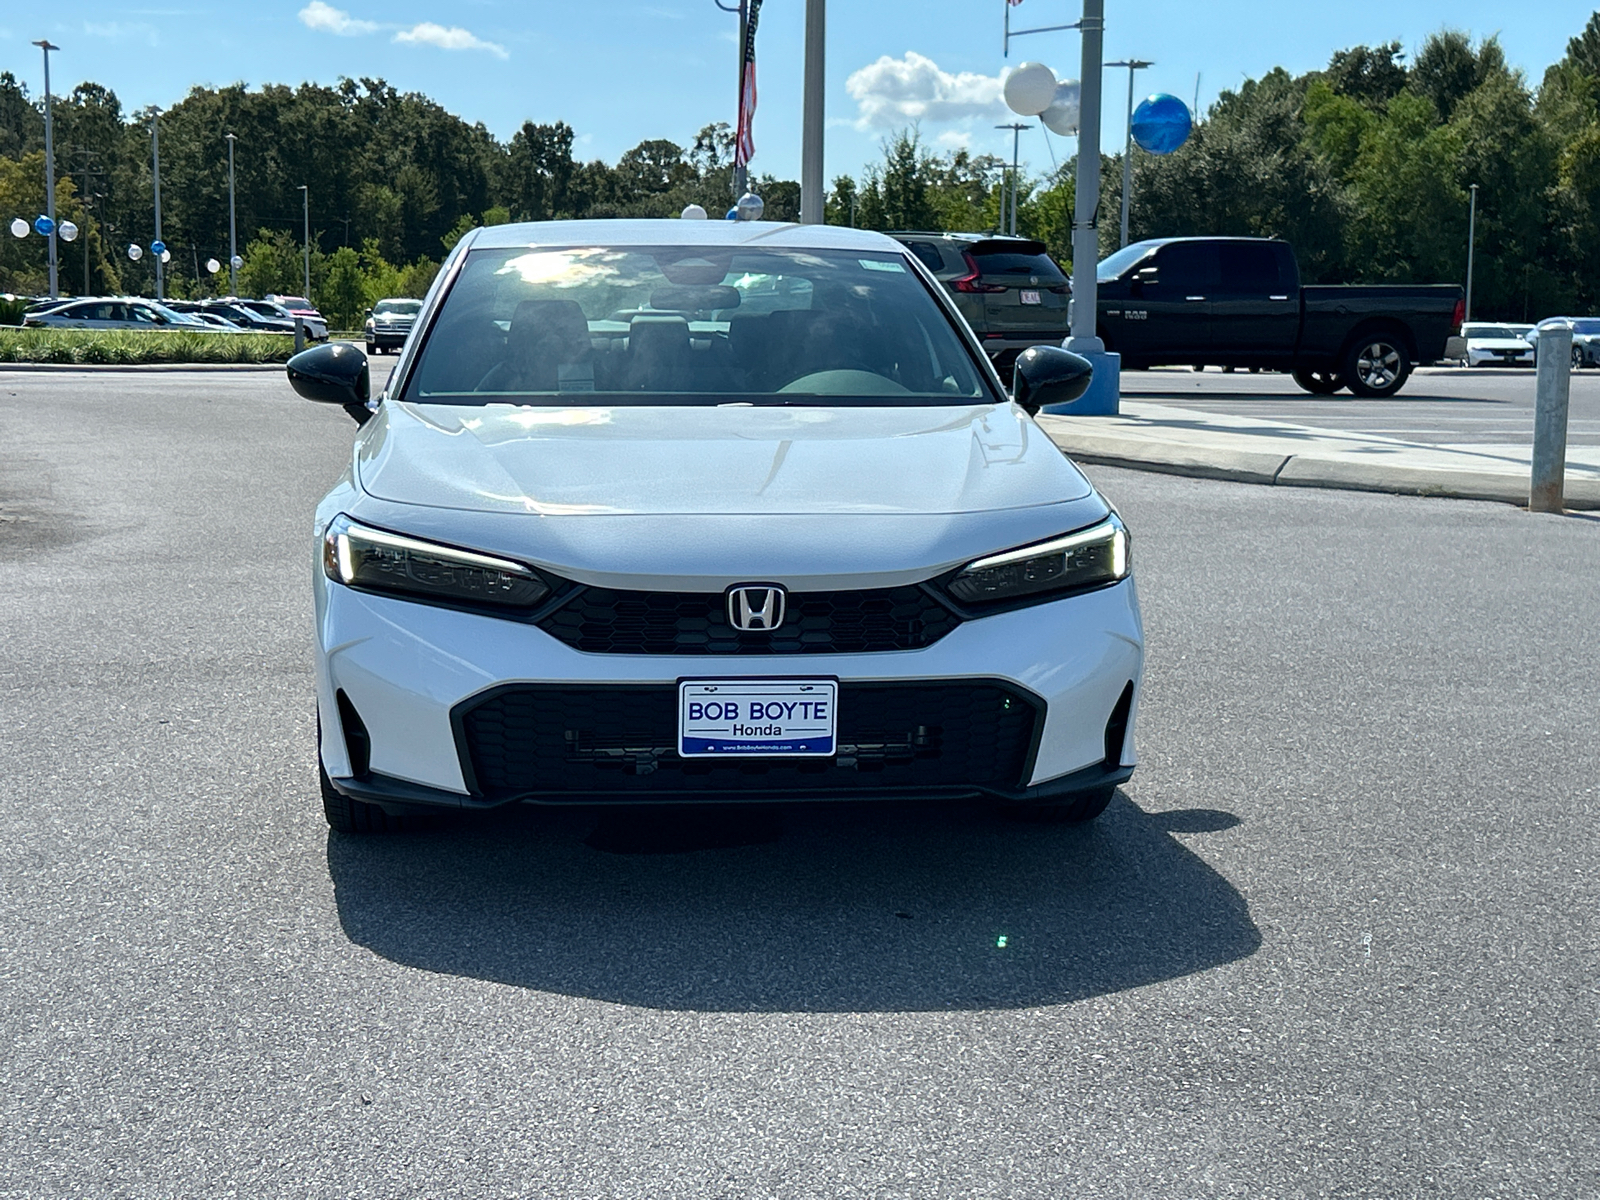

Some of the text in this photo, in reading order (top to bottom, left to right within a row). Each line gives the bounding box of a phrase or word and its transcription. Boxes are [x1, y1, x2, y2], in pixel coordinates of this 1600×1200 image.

[689, 702, 828, 721] BOB BOYTE
[733, 724, 782, 736] Honda
